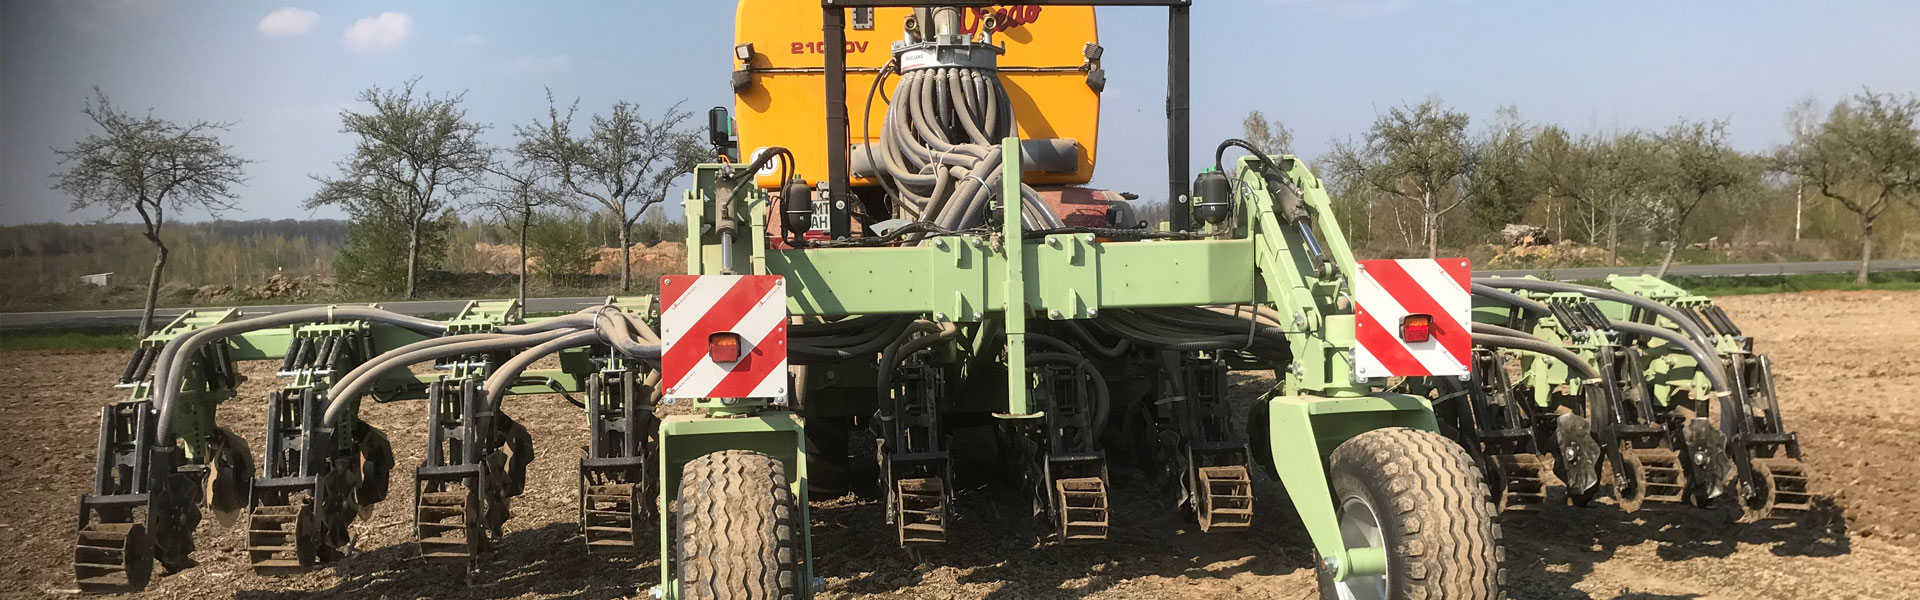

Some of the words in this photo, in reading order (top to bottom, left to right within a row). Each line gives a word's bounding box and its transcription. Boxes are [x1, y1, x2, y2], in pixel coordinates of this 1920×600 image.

[960, 5, 1042, 37] Vedo
[791, 41, 869, 54] 2100V
[758, 153, 773, 170] 0
[813, 202, 830, 215] MT
[811, 216, 828, 229] AH
